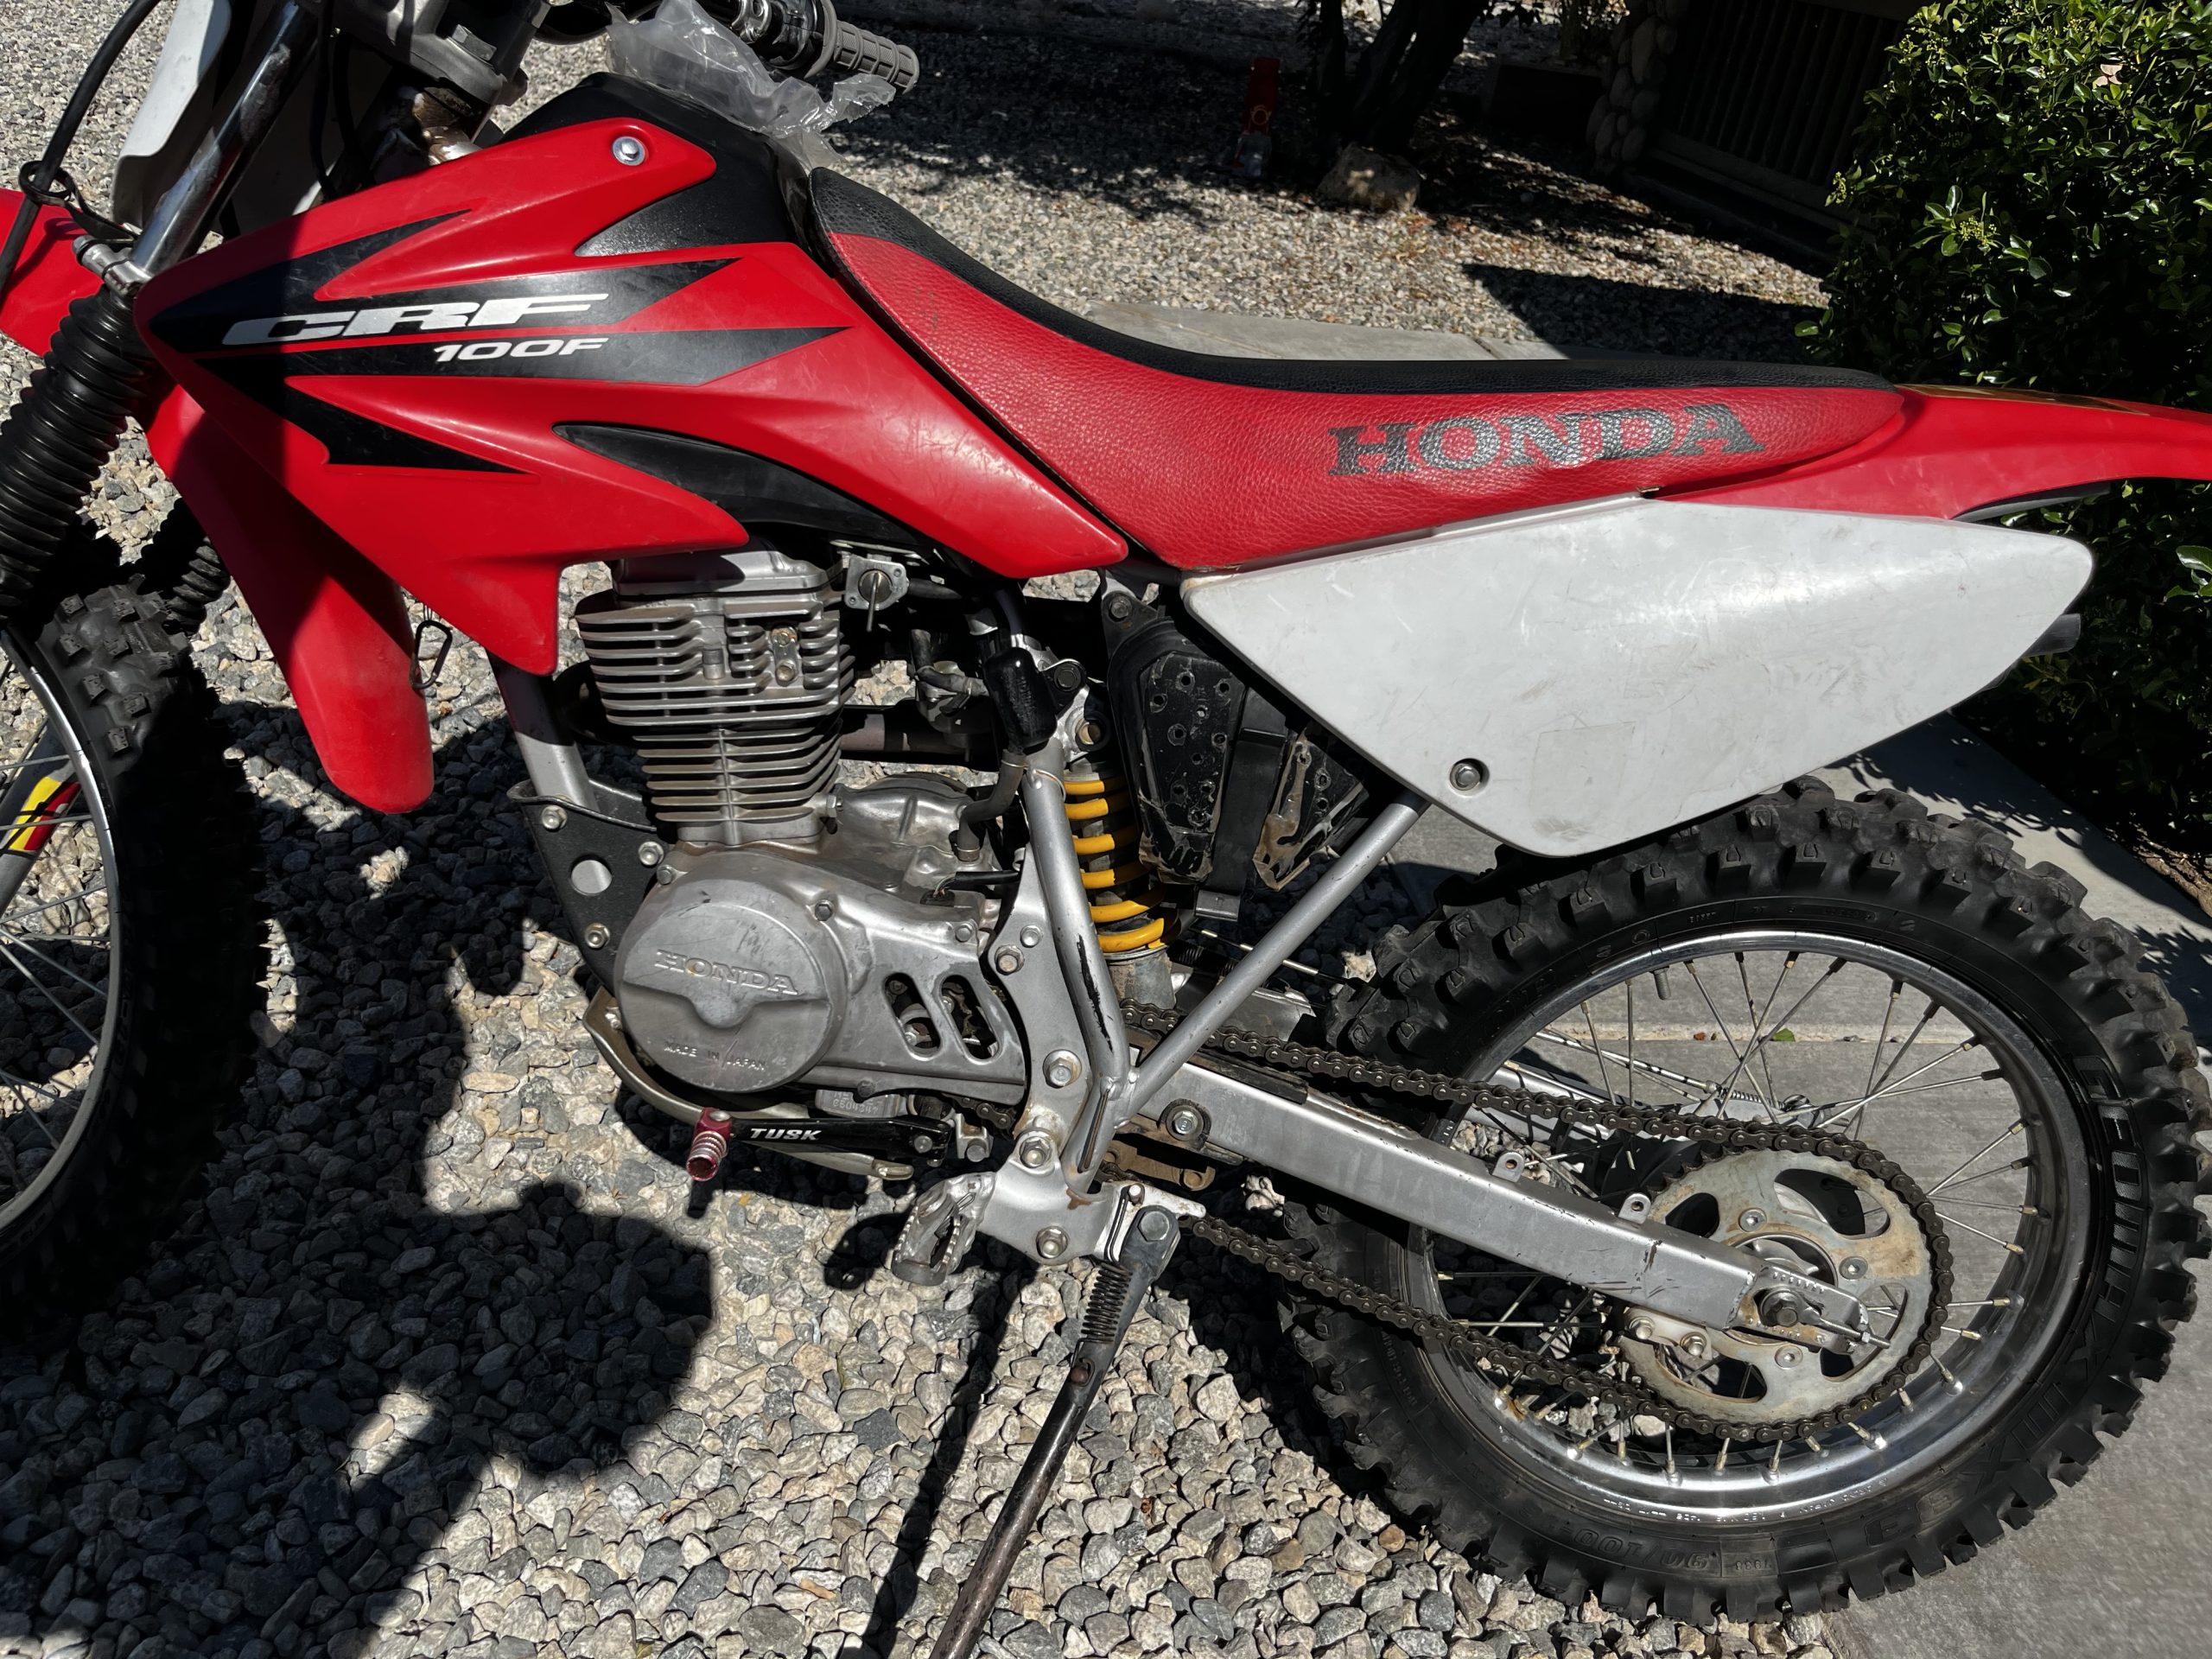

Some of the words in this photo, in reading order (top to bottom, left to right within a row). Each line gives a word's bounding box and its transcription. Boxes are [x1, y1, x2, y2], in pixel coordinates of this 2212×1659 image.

[222, 293, 609, 346] CRF
[433, 337, 608, 362] 100F
[1328, 404, 1767, 475] HONDA
[654, 949, 799, 995] HONDA
[664, 1041, 697, 1058] MADE
[707, 1049, 721, 1061] IN
[727, 1054, 766, 1071] JAPAN
[750, 1128, 822, 1141] TUSK
